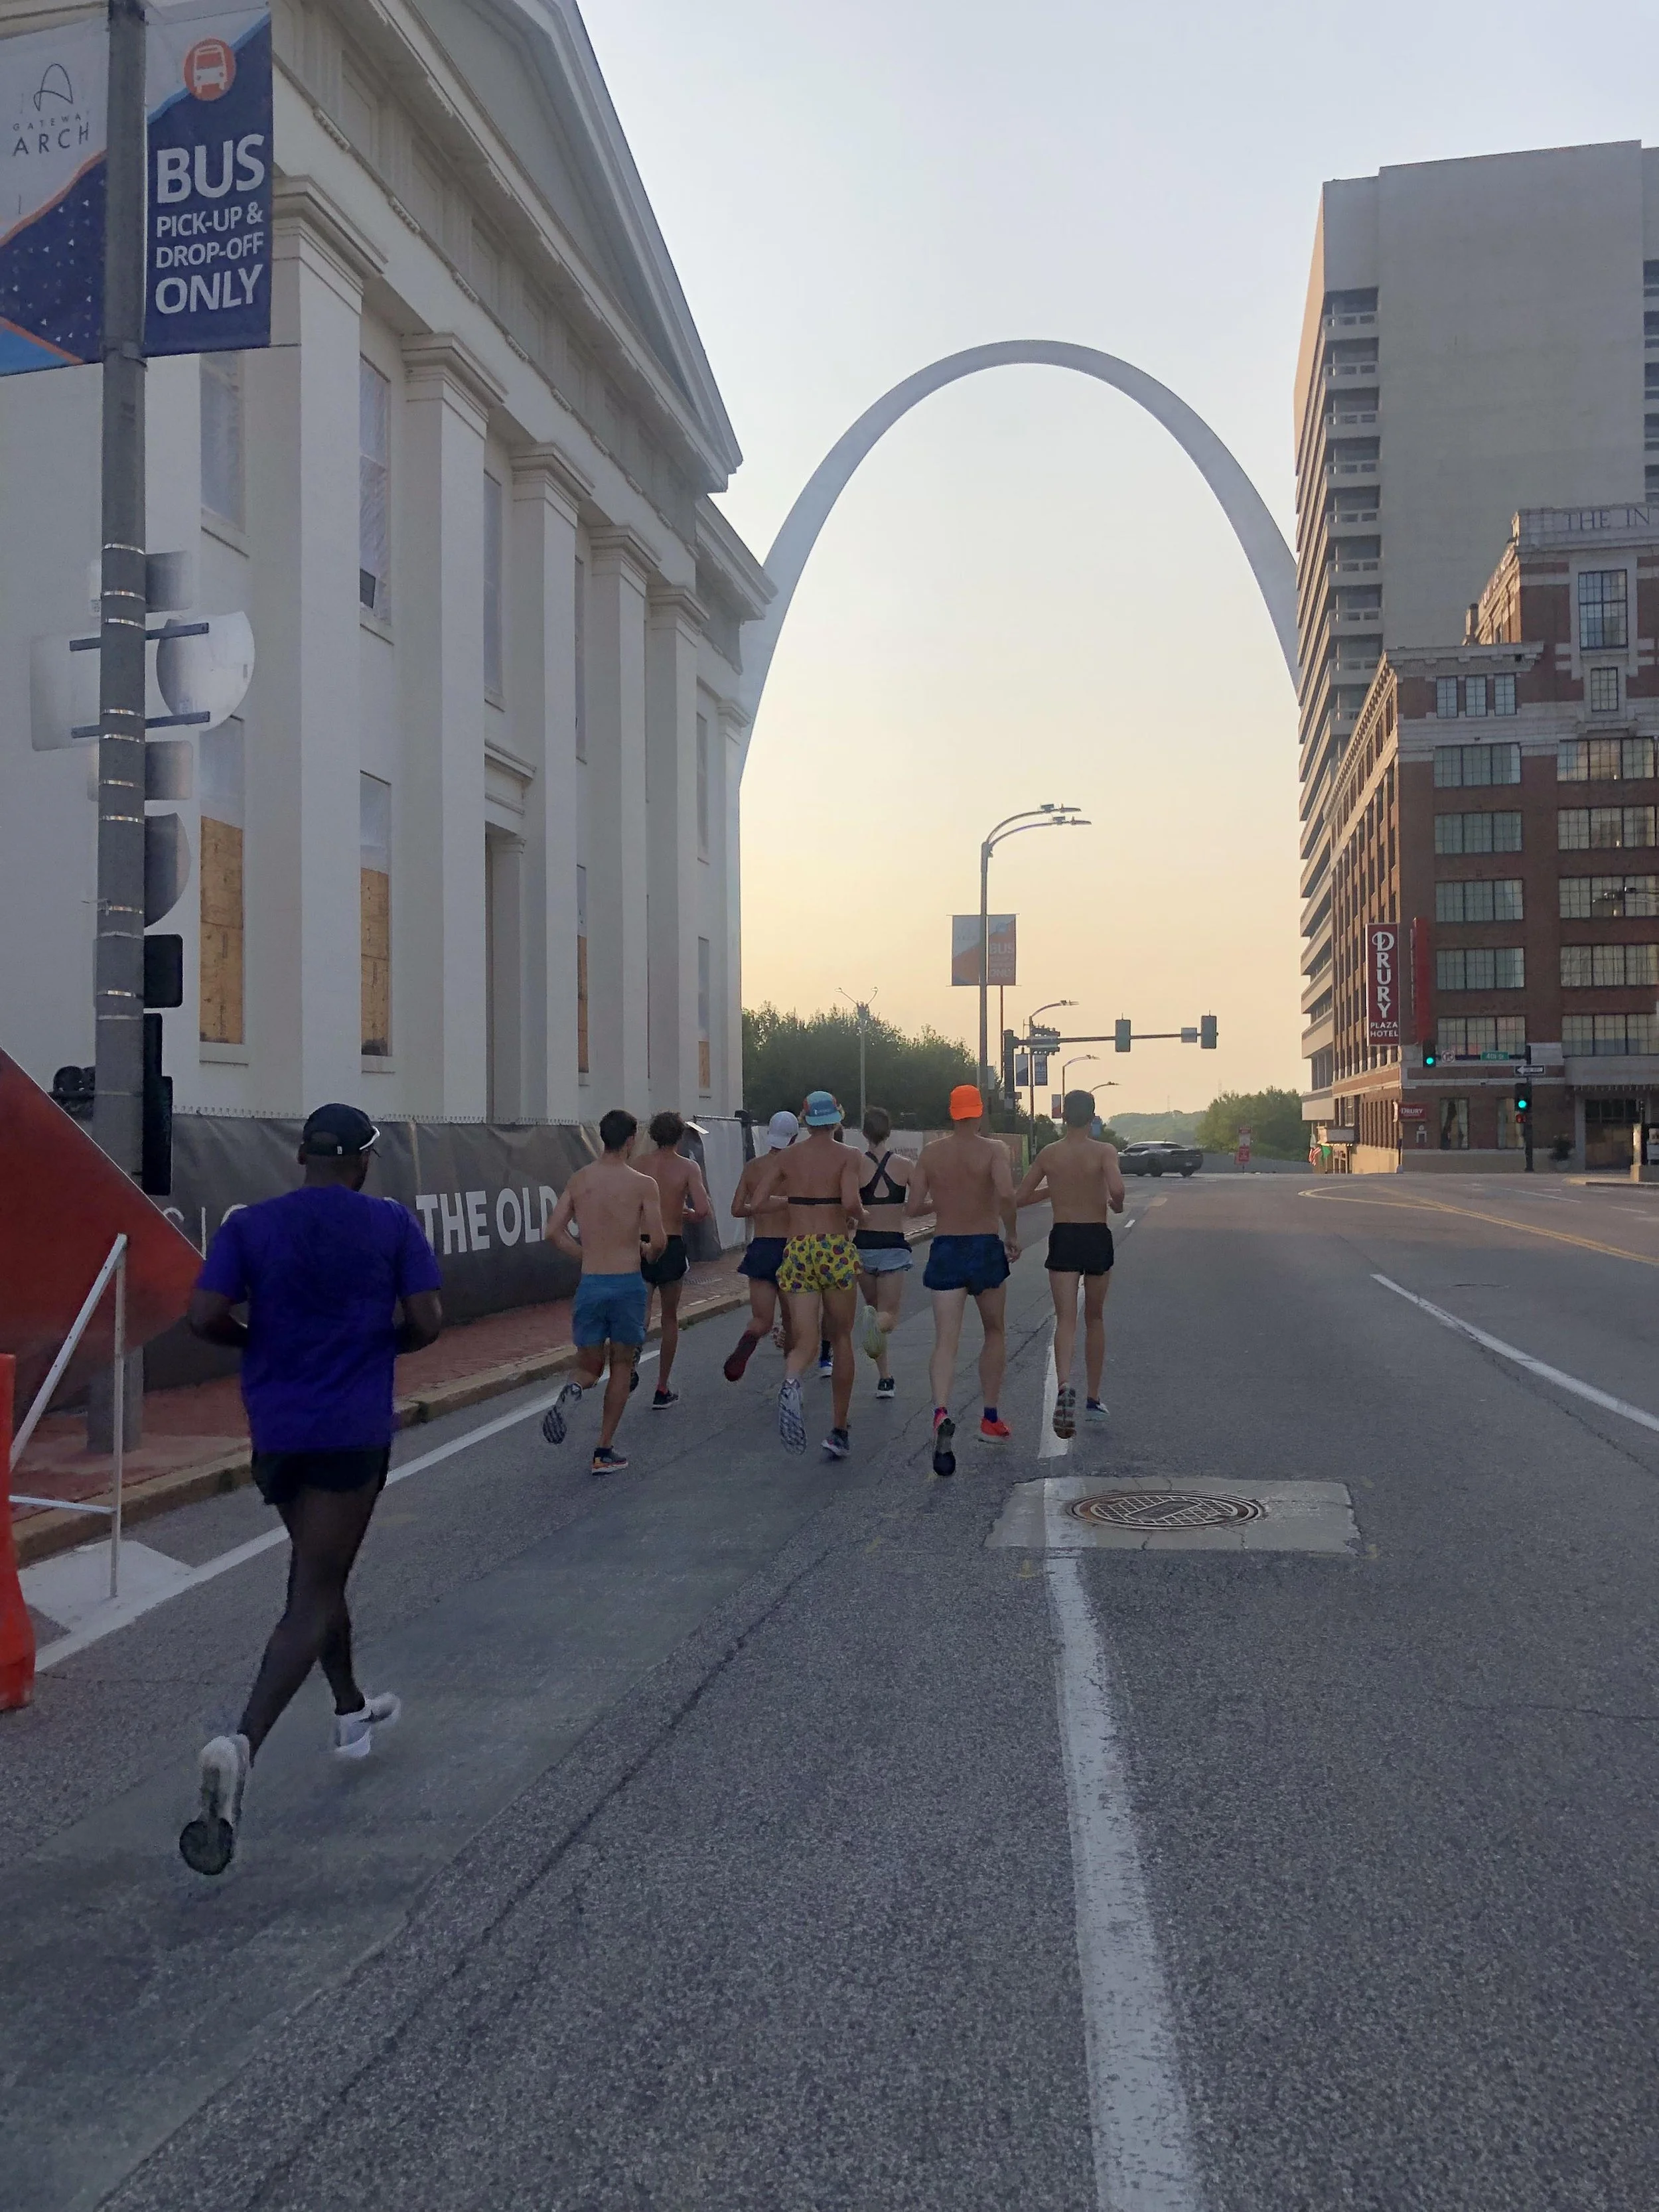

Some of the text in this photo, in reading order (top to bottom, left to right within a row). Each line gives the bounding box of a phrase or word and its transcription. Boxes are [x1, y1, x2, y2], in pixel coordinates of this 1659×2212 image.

[12, 121, 89, 157] ARCH
[157, 133, 265, 204] BUS
[157, 202, 263, 238] PICK-UP &
[156, 232, 264, 268] DROP-OFF
[155, 264, 263, 314] ONLY
[1564, 508, 1611, 530] THE
[1372, 931, 1394, 1019] DRURY
[415, 1191, 490, 1254] THE
